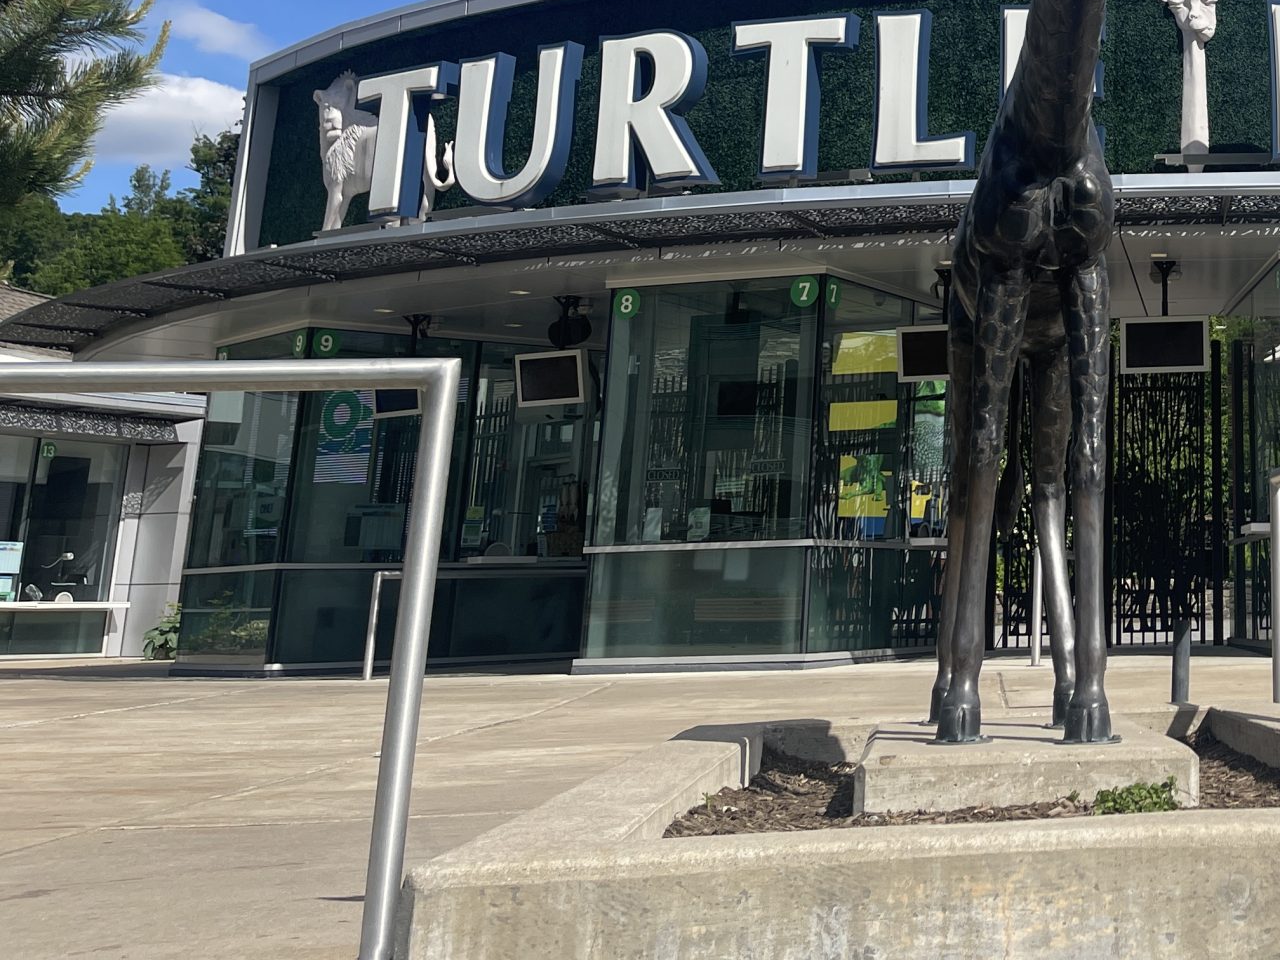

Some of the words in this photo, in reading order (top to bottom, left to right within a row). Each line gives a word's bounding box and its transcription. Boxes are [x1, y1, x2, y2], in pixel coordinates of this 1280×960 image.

[798, 282, 811, 301] 7
[830, 284, 837, 303] 7
[620, 294, 633, 313] 8
[295, 335, 303, 352] 9
[320, 334, 333, 352] 9
[42, 445, 55, 457] 13
[647, 470, 680, 481] CLOSED
[751, 461, 785, 473] CLOSED
